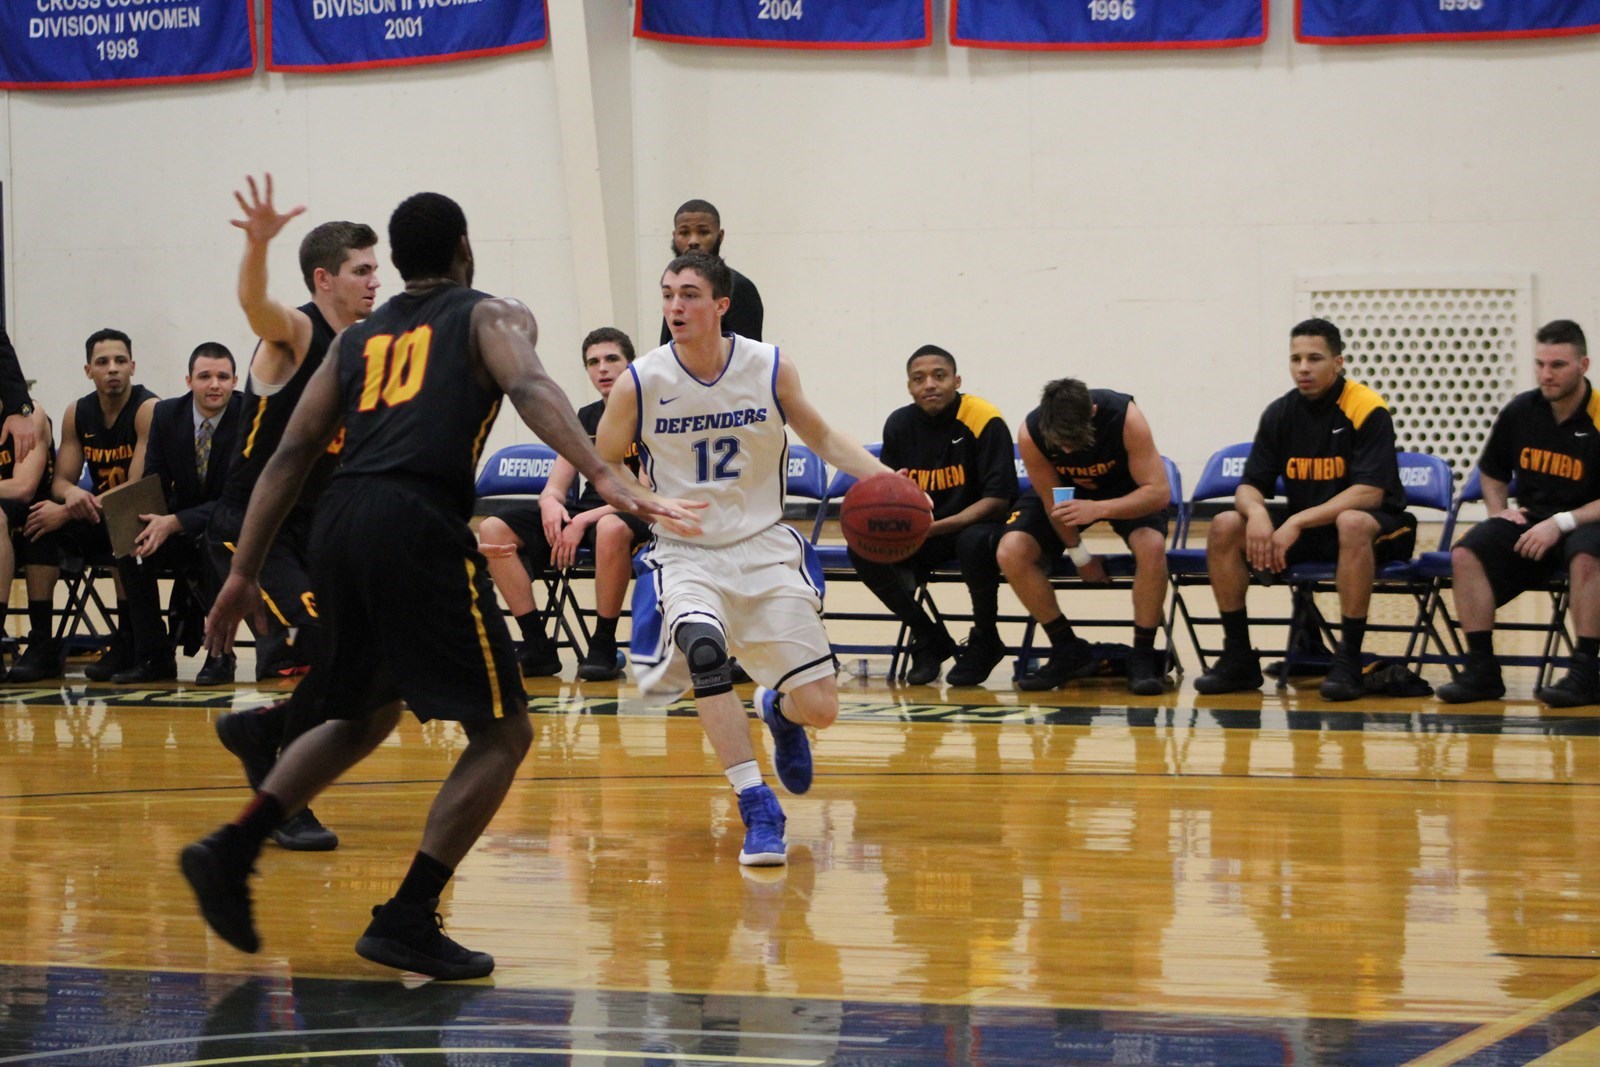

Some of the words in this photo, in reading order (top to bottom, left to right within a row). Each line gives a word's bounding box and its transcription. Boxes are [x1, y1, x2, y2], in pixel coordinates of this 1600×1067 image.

[29, 15, 111, 38] DIVISION
[115, 15, 125, 34] II
[128, 7, 200, 32] WOMEN
[758, 0, 803, 20] 2004
[1088, 0, 1136, 21] 1996
[384, 16, 423, 40] 2001
[97, 38, 139, 60] 1998
[357, 323, 433, 413] 10
[654, 408, 768, 434] DEFENDERS
[691, 435, 741, 484] 12
